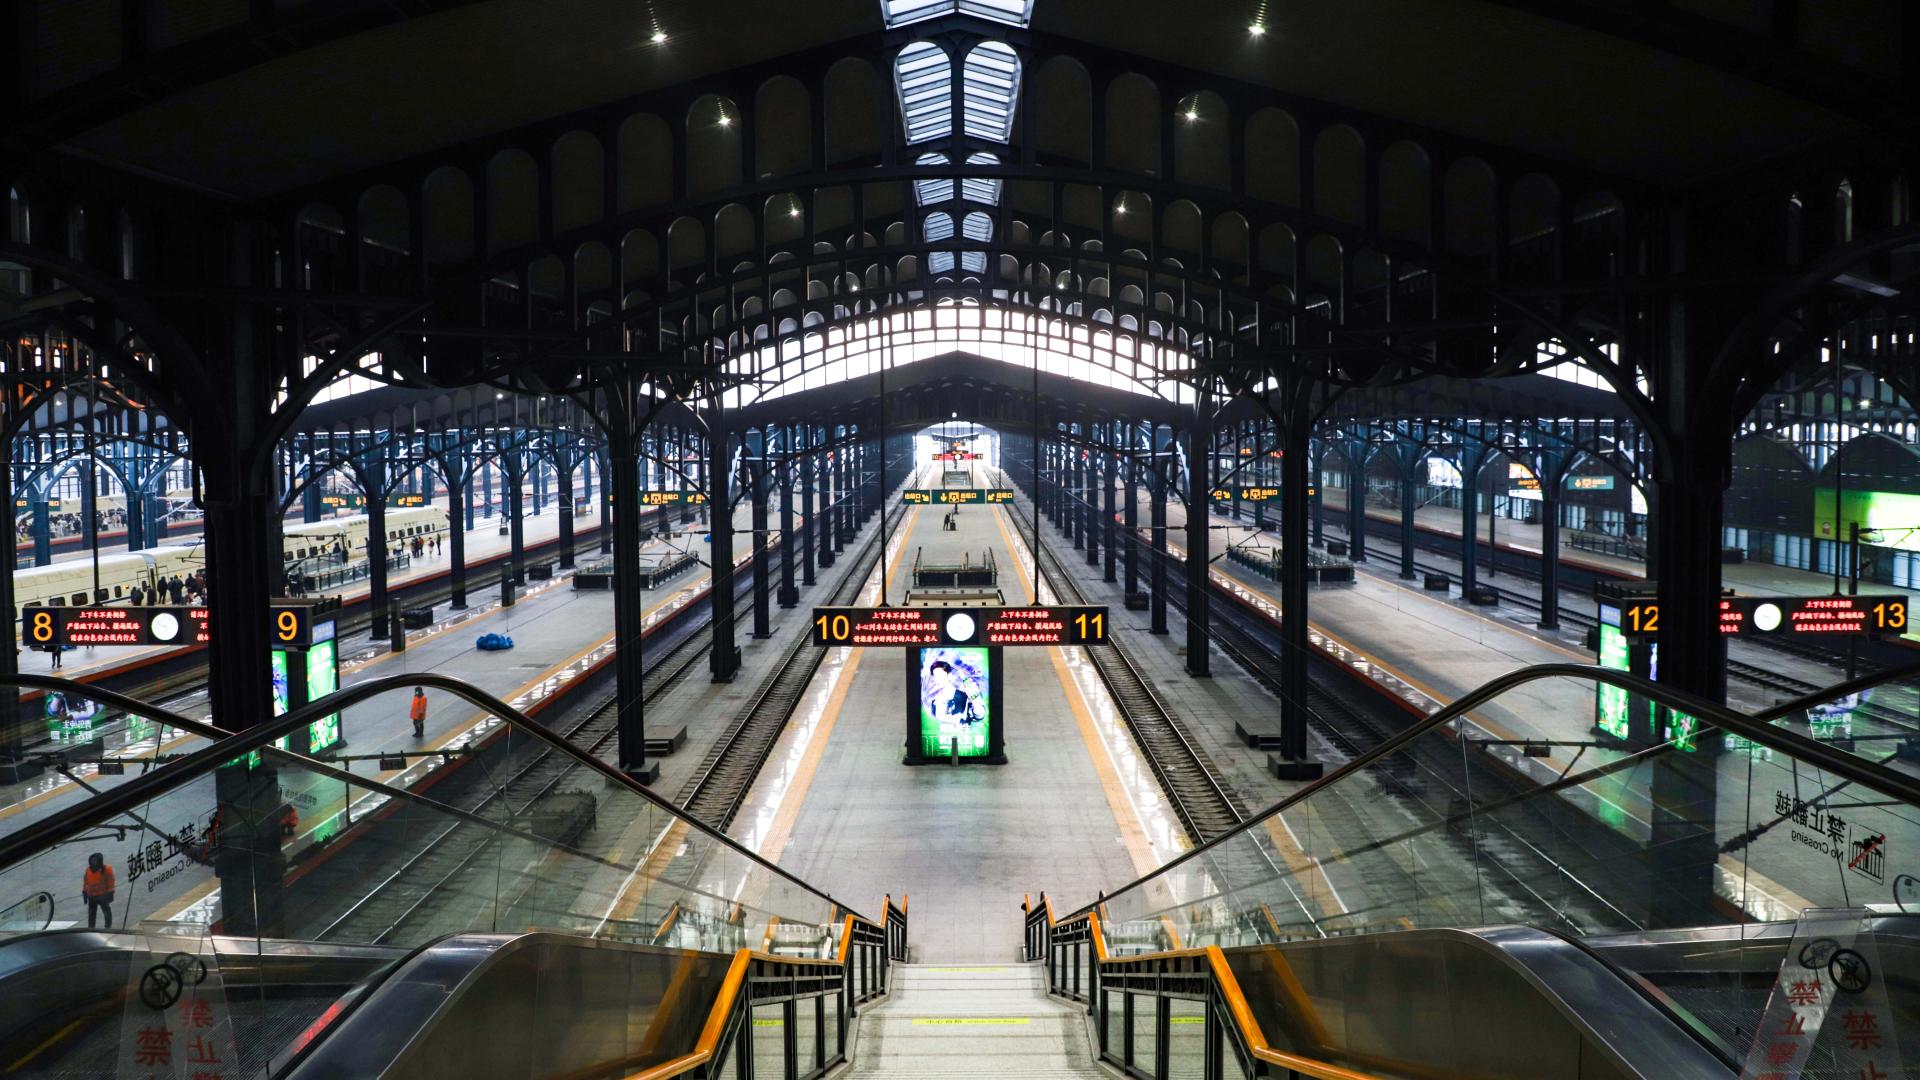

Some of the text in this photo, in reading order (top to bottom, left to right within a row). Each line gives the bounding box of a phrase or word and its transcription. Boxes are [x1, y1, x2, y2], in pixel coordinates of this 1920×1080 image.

[33, 612, 53, 641] 8
[277, 611, 298, 640] 9
[816, 615, 849, 640] 10
[872, 612, 921, 620] 上下车不要拥挤
[1075, 614, 1103, 639] 11
[1628, 606, 1659, 631] 12
[1872, 603, 1905, 628] 13
